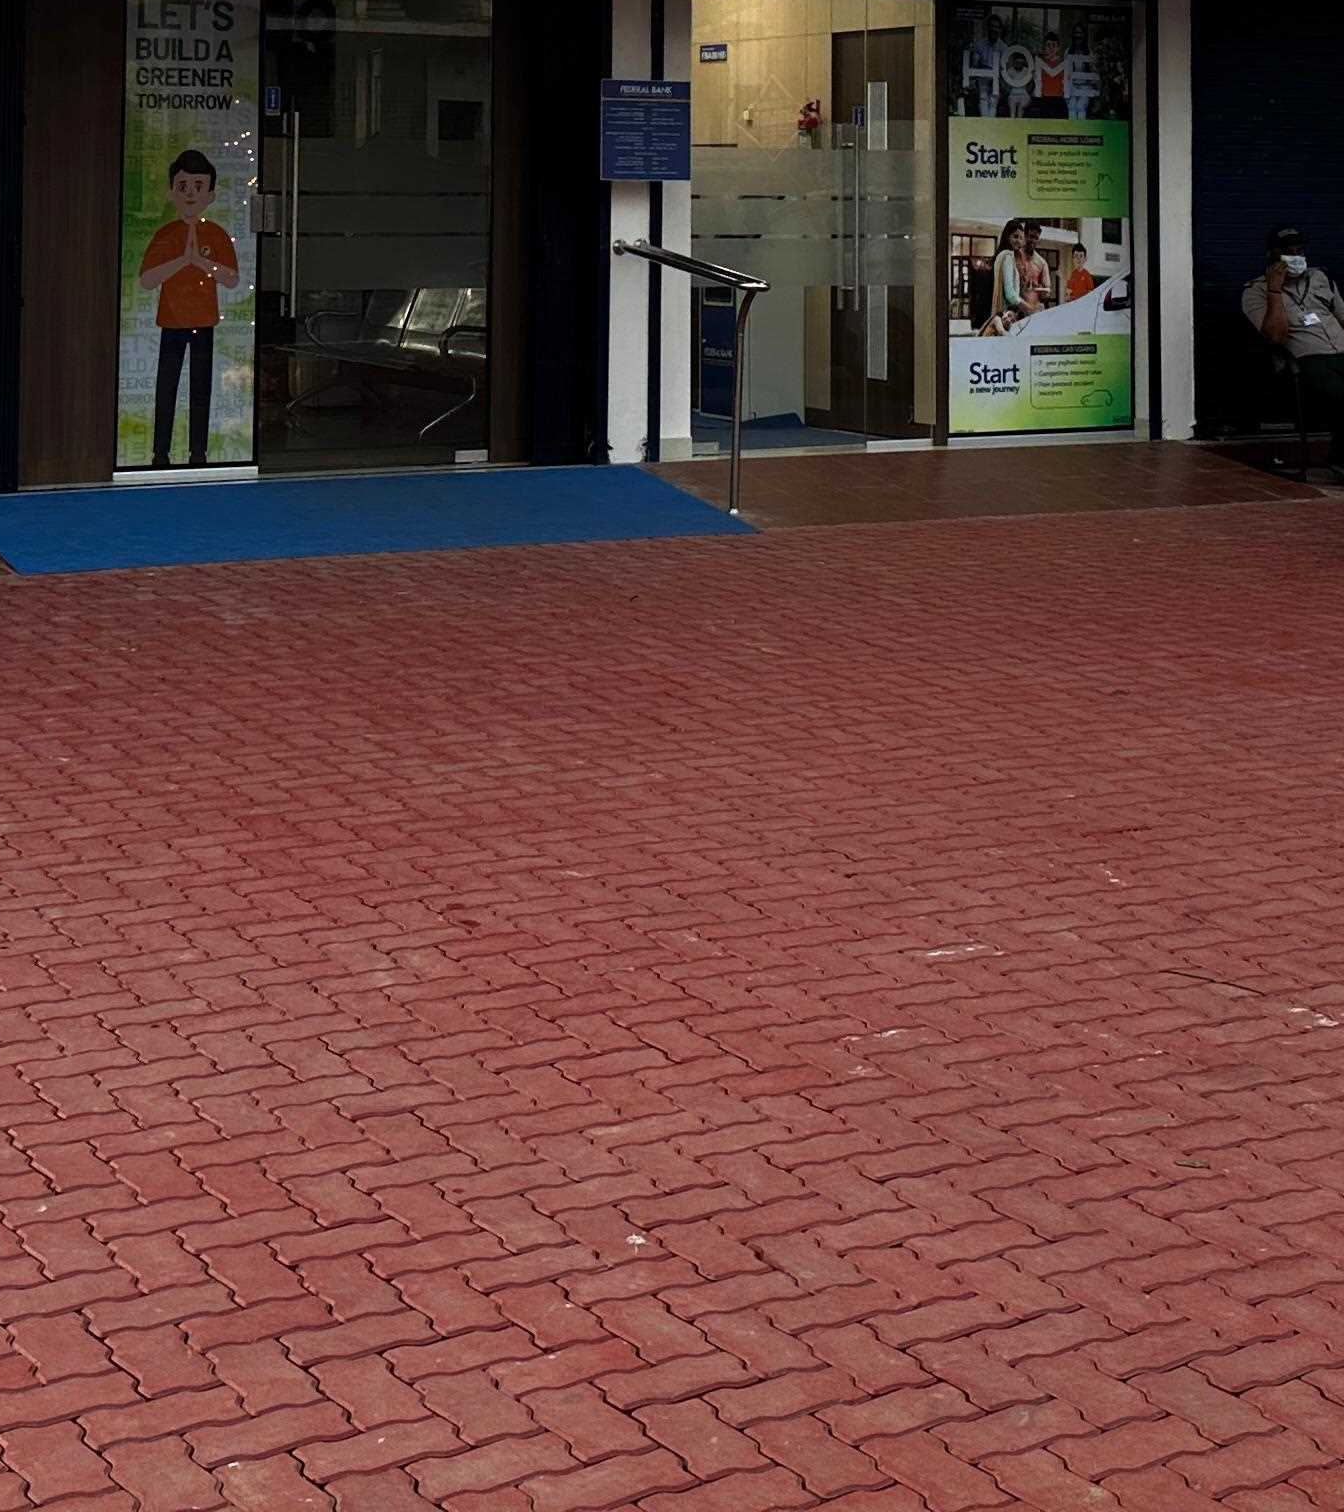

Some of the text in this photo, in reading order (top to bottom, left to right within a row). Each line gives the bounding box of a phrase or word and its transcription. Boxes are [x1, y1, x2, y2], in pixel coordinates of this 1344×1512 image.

[137, 0, 234, 31] LET'S
[136, 38, 233, 62] BUILD A
[136, 68, 233, 87] GREENER
[136, 93, 233, 109] TOMORROW
[966, 141, 1017, 164] Start
[975, 169, 998, 178] new
[969, 362, 1019, 384] Start
